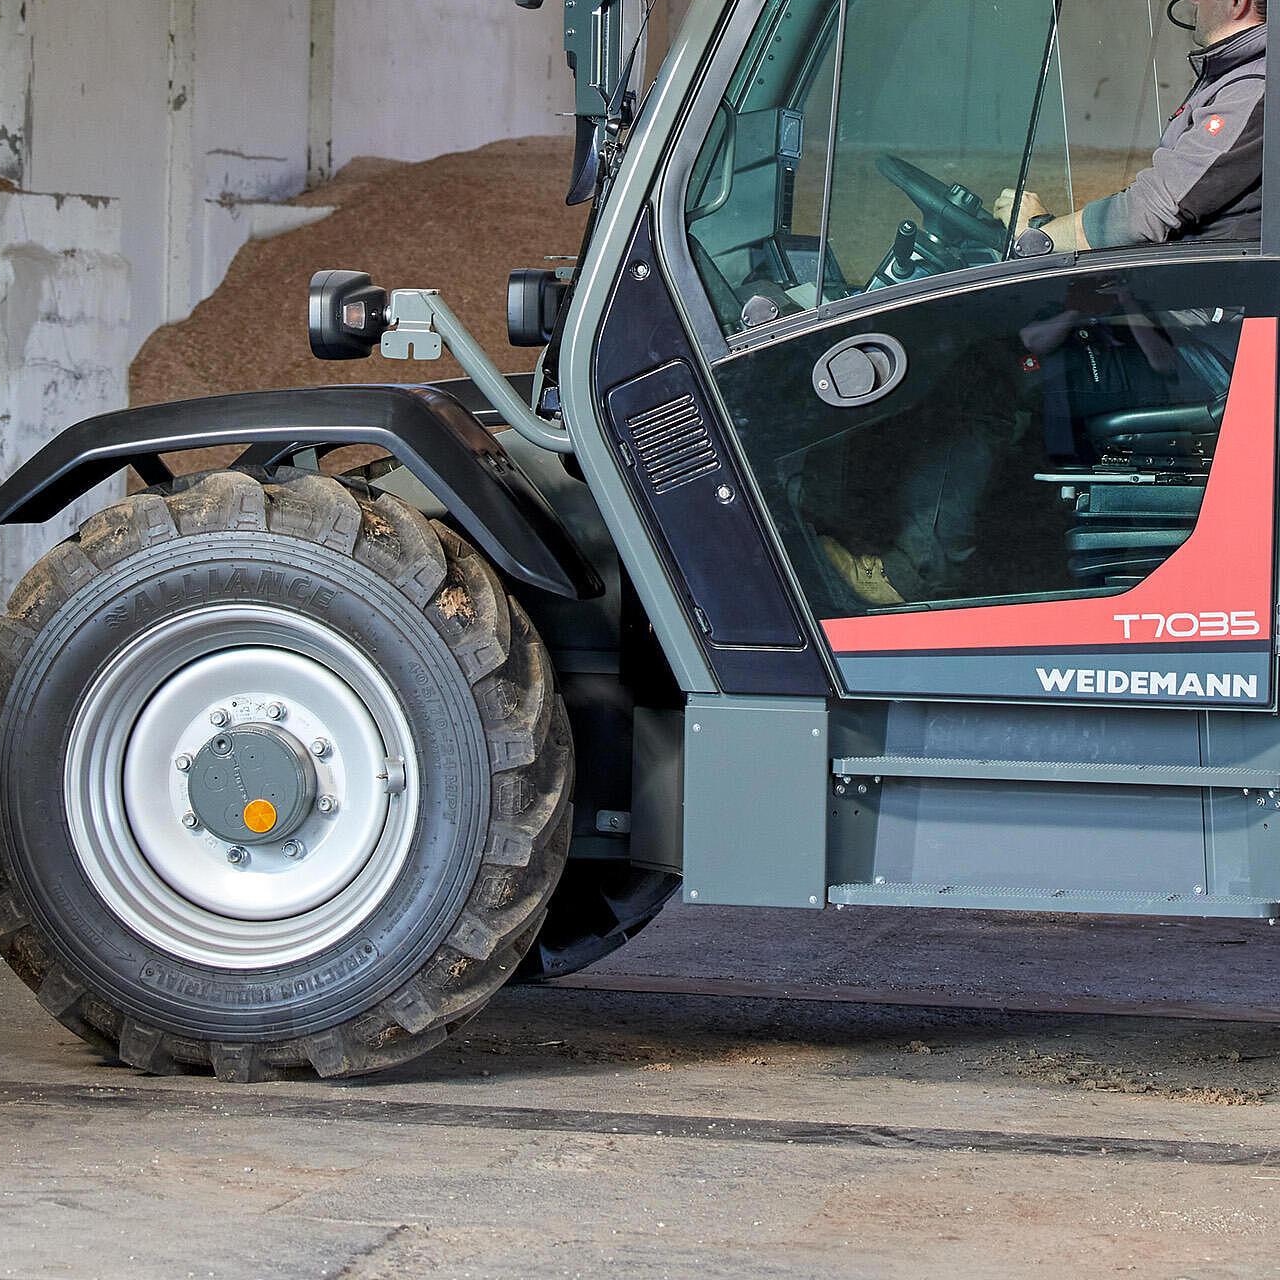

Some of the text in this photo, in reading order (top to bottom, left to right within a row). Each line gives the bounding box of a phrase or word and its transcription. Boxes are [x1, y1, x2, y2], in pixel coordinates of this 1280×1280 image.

[132, 567, 339, 616] ALLIANCE
[1113, 611, 1260, 639] T7035
[1036, 668, 1257, 698] WEIDEMANN
